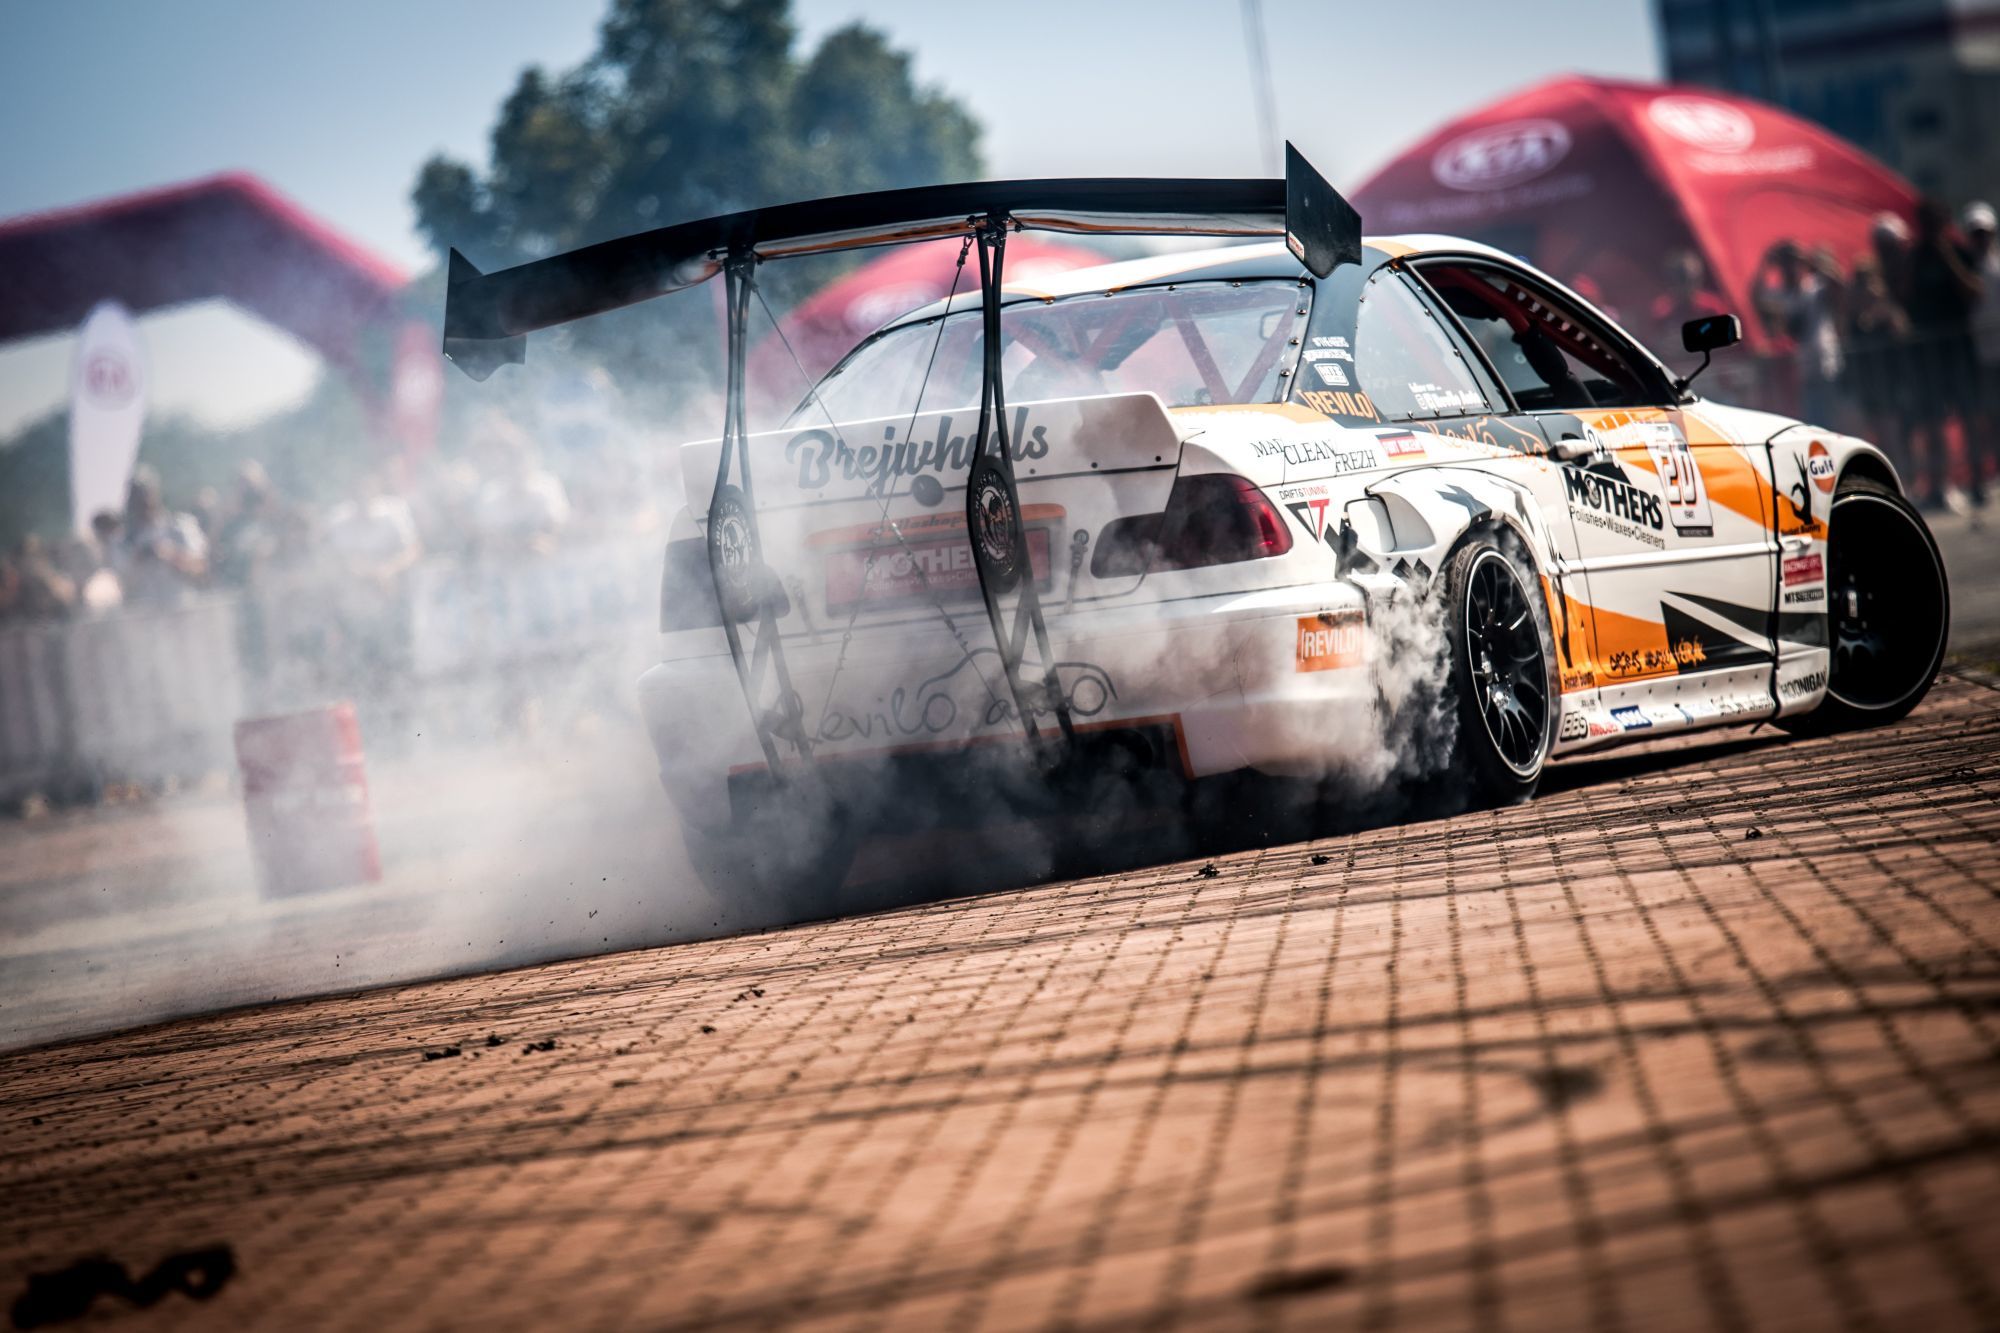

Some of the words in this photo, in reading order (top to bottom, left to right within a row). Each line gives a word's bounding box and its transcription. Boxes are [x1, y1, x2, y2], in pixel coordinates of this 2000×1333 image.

[1284, 439, 1337, 465] CLEAN
[1335, 450, 1377, 472] FREZH
[1659, 438, 1697, 505] 20
[1809, 458, 1835, 476] Gulf
[1562, 467, 1664, 531] MOTHERS
[864, 544, 977, 581] MOTHE
[1560, 711, 1589, 743] BBS
